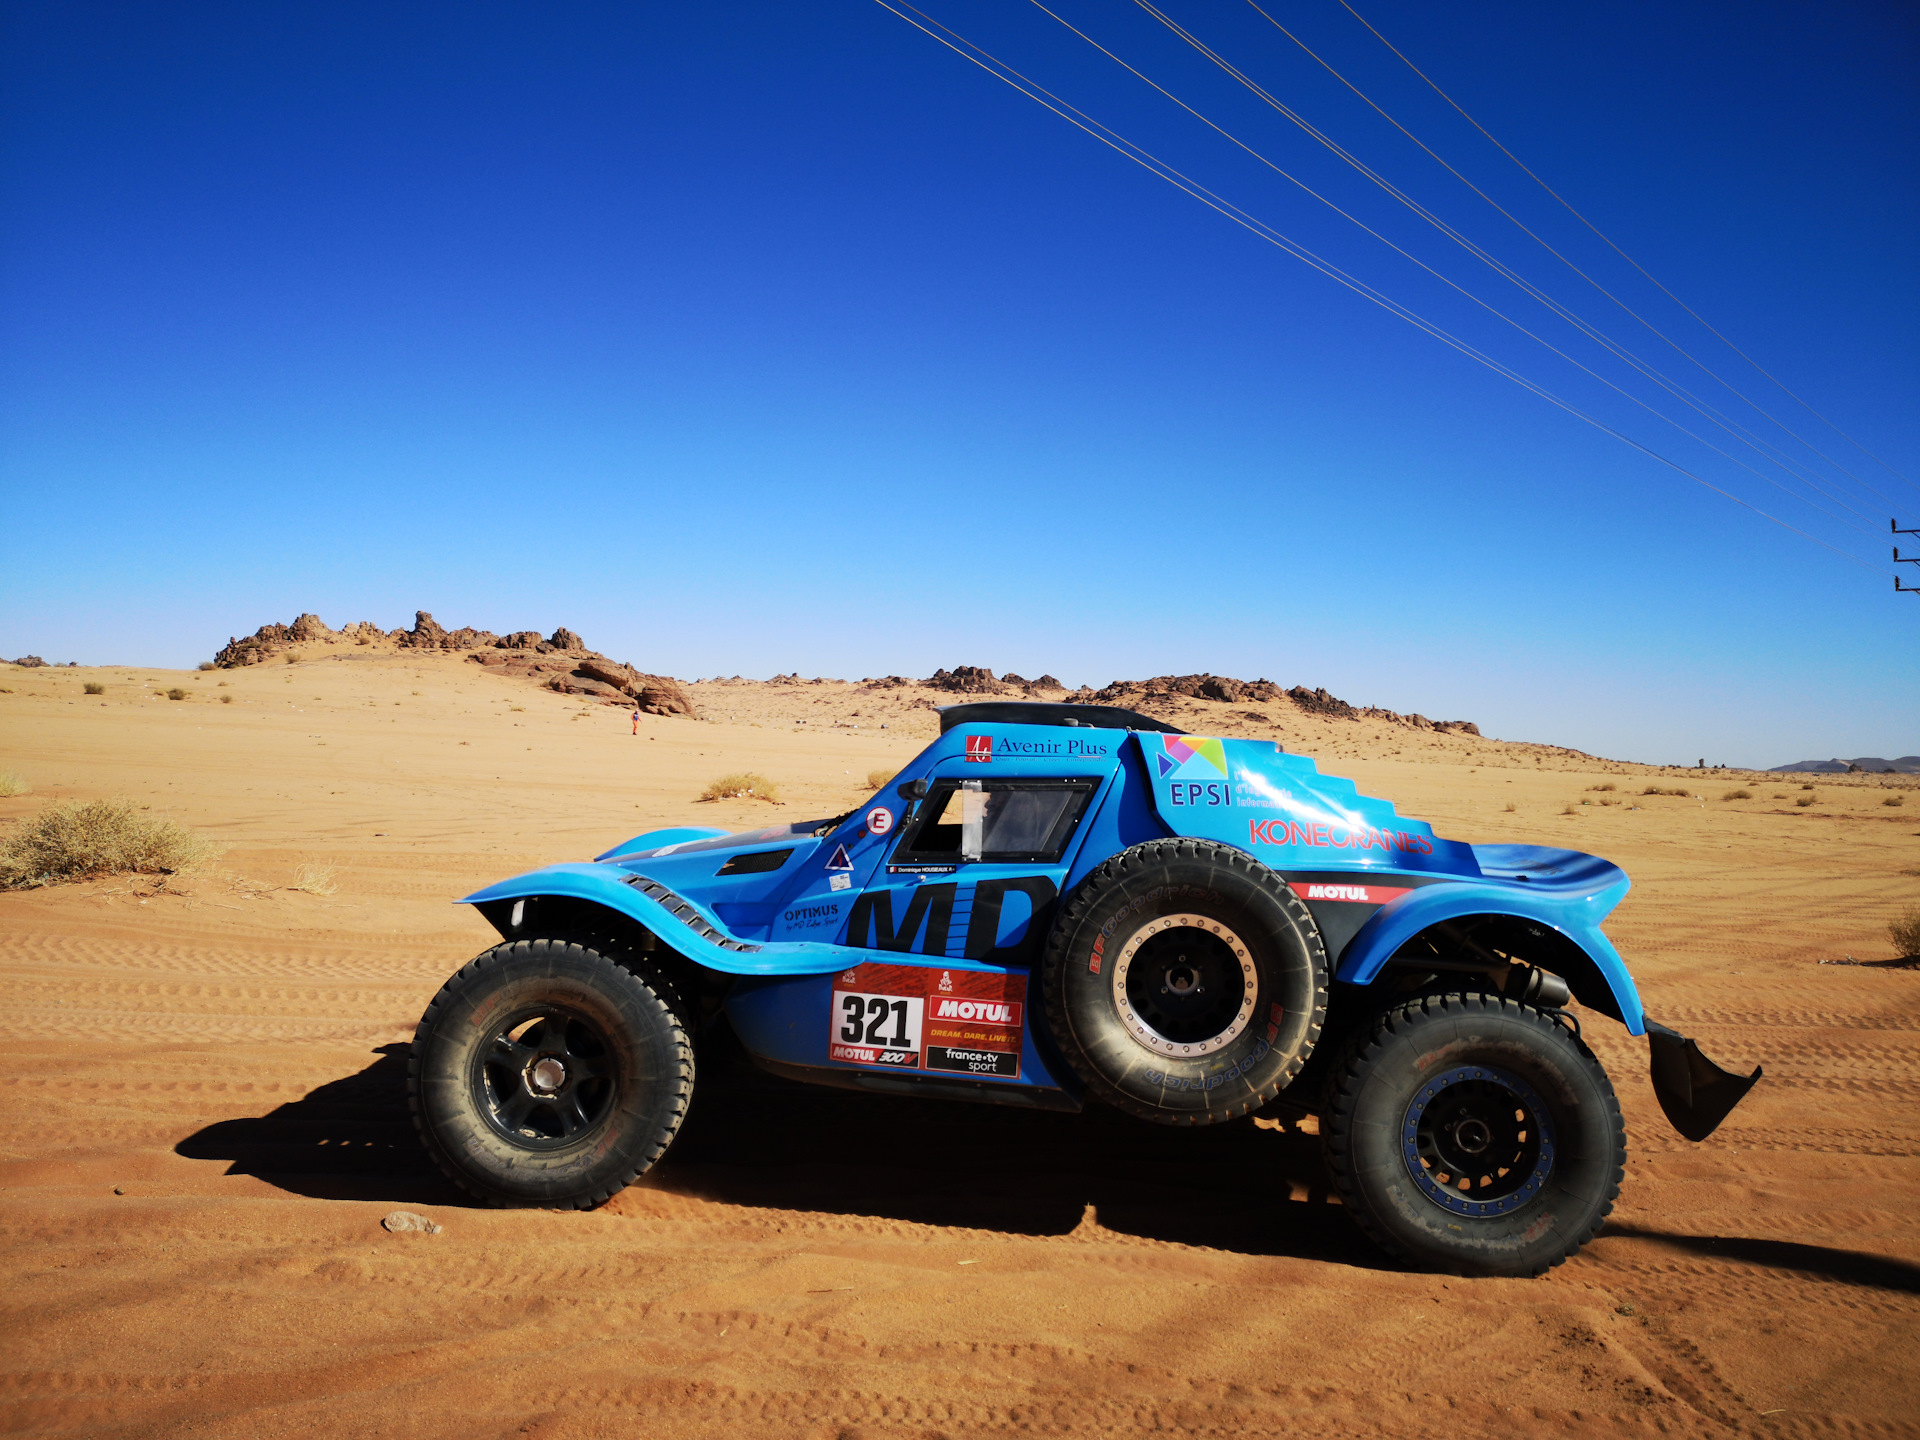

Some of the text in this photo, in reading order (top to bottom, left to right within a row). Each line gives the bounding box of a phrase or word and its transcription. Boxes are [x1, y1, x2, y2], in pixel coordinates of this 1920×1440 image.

[997, 737, 1107, 755] Avenir Plus
[1170, 783, 1231, 806] EPSI
[873, 813, 886, 829] E
[1249, 819, 1433, 856] KONECRANES
[1307, 885, 1369, 901] MOTUL
[784, 904, 838, 921] OPTIMUS
[937, 999, 1012, 1022] MOTUL
[840, 995, 911, 1048] 321
[930, 1029, 962, 1038] DREAM.
[964, 1032, 987, 1040] DARE.
[988, 1034, 1007, 1042] LIVE
[833, 1046, 918, 1064] MOTUL 300V
[968, 1061, 997, 1073] sport
